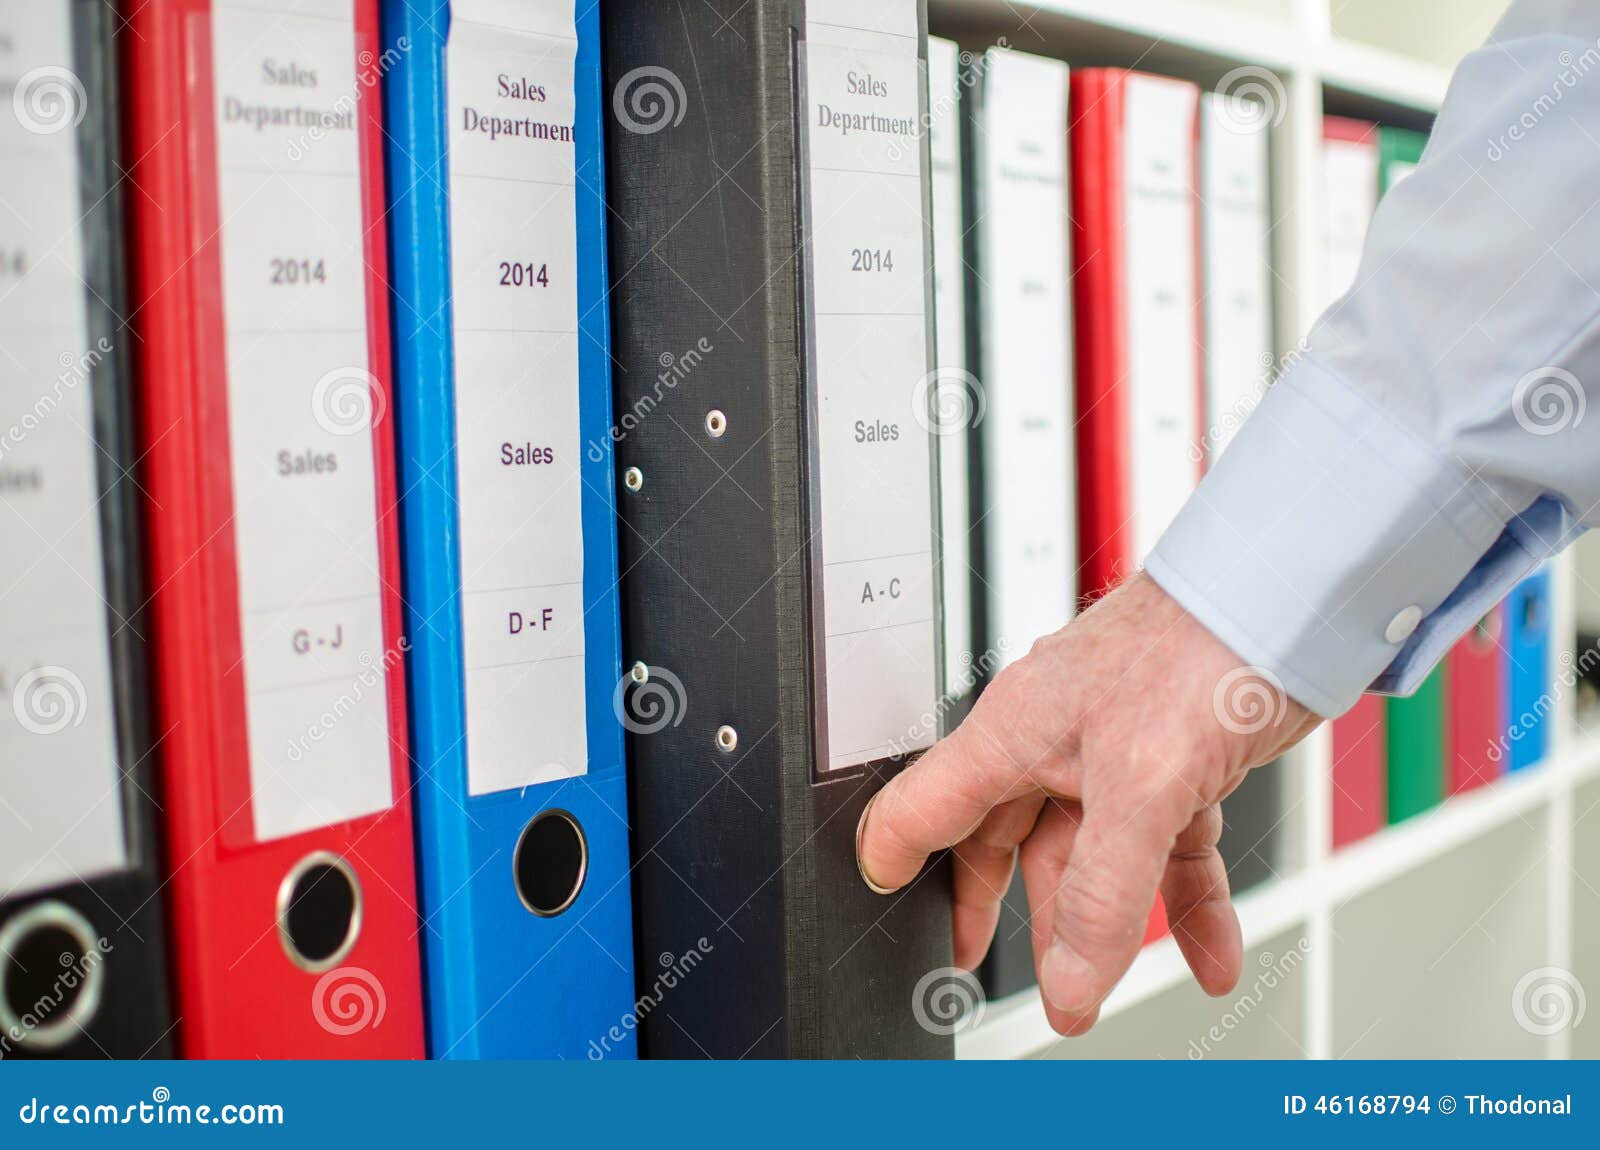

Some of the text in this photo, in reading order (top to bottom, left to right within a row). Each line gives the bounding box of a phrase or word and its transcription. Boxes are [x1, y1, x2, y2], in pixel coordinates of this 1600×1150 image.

[260, 57, 318, 88] Sales
[847, 71, 888, 98] Sales
[497, 73, 546, 102] Sales
[223, 95, 354, 132] Department
[818, 103, 914, 136] Department
[269, 258, 327, 285] 2014
[851, 248, 893, 272] 2014
[499, 262, 549, 288] 2014
[855, 420, 899, 443] Sales
[277, 449, 338, 477] Sales
[501, 442, 554, 466] Sales
[861, 582, 874, 603] A
[889, 577, 900, 599] C
[509, 612, 522, 634] D
[542, 608, 553, 631] F
[292, 629, 311, 655] G
[330, 623, 343, 649] J
